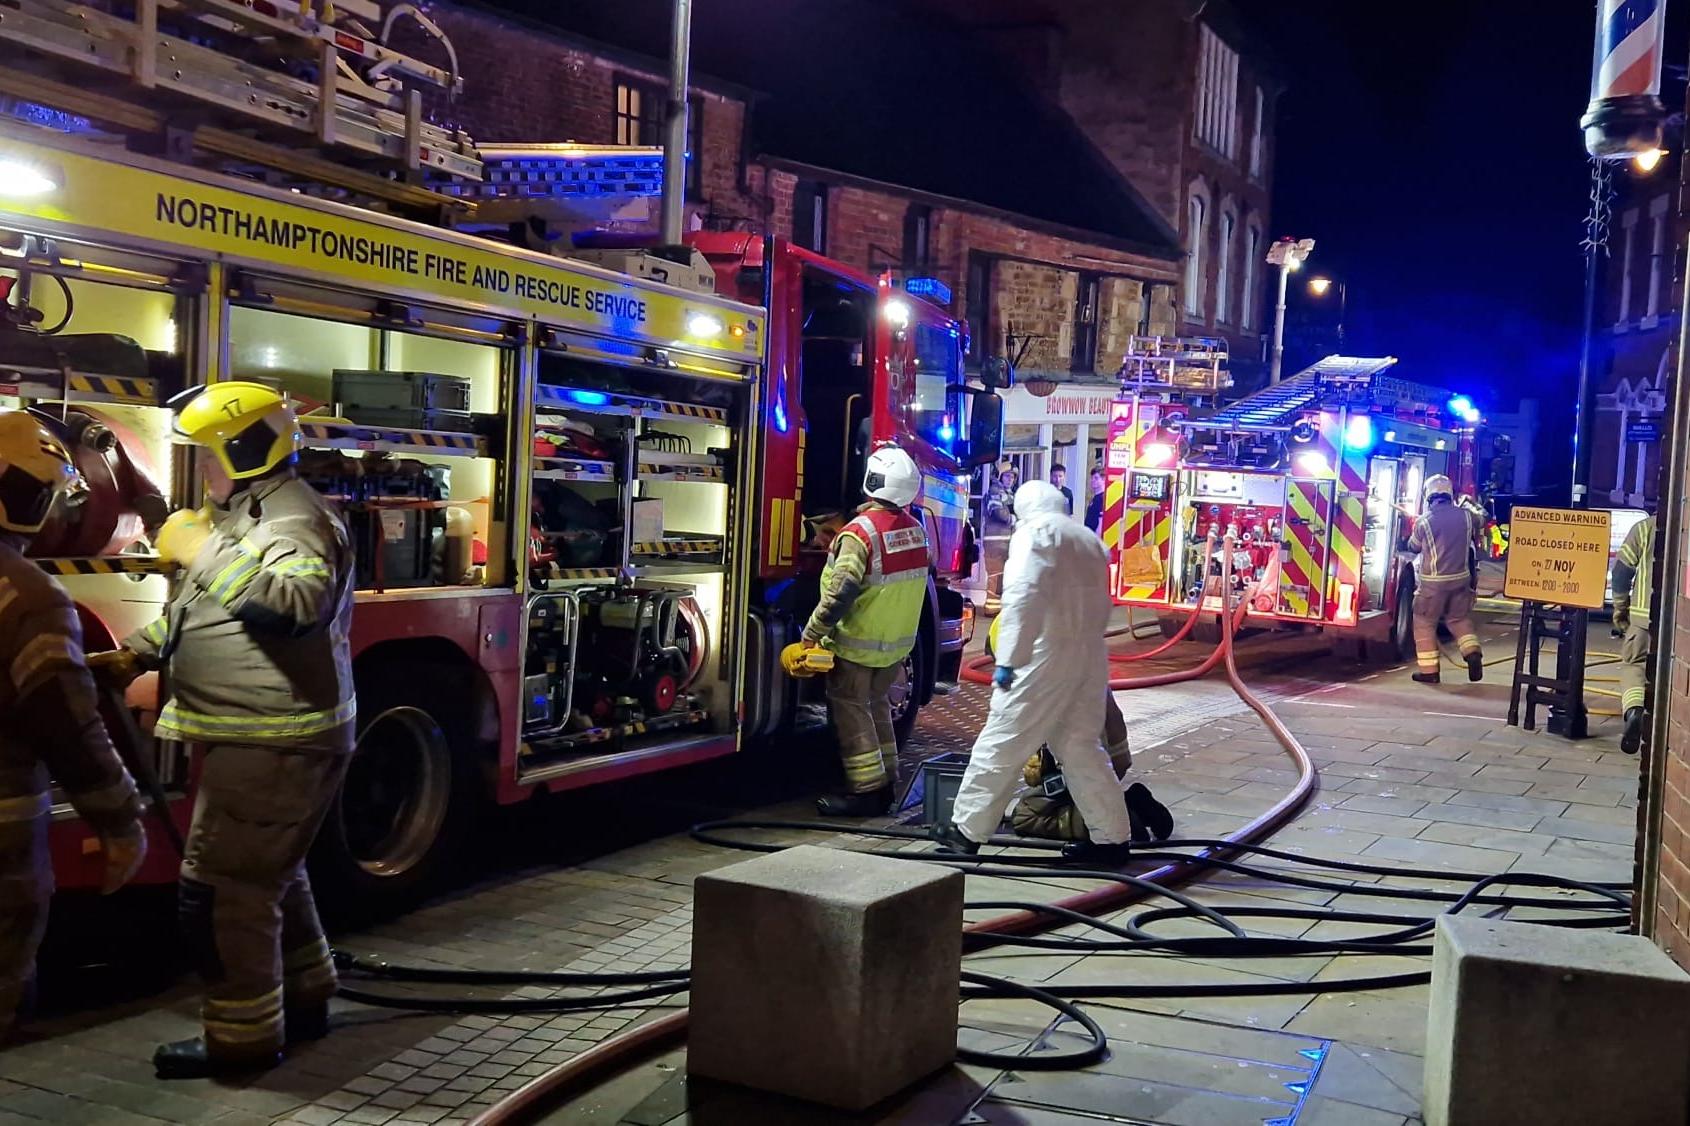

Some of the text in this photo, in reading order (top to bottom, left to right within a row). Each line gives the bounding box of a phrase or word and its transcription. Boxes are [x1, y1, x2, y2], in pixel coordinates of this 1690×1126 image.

[156, 193, 646, 322] NORTHAMPTONSHIRE FIRE AND RESCUE SERVICE
[220, 398, 242, 419] 17
[1088, 397, 1112, 414] BEAUT
[1514, 510, 1607, 525] ADVANCED WARNING
[1515, 537, 1601, 553] ROAD CLOSED HERE
[1554, 560, 1575, 573] NOV
